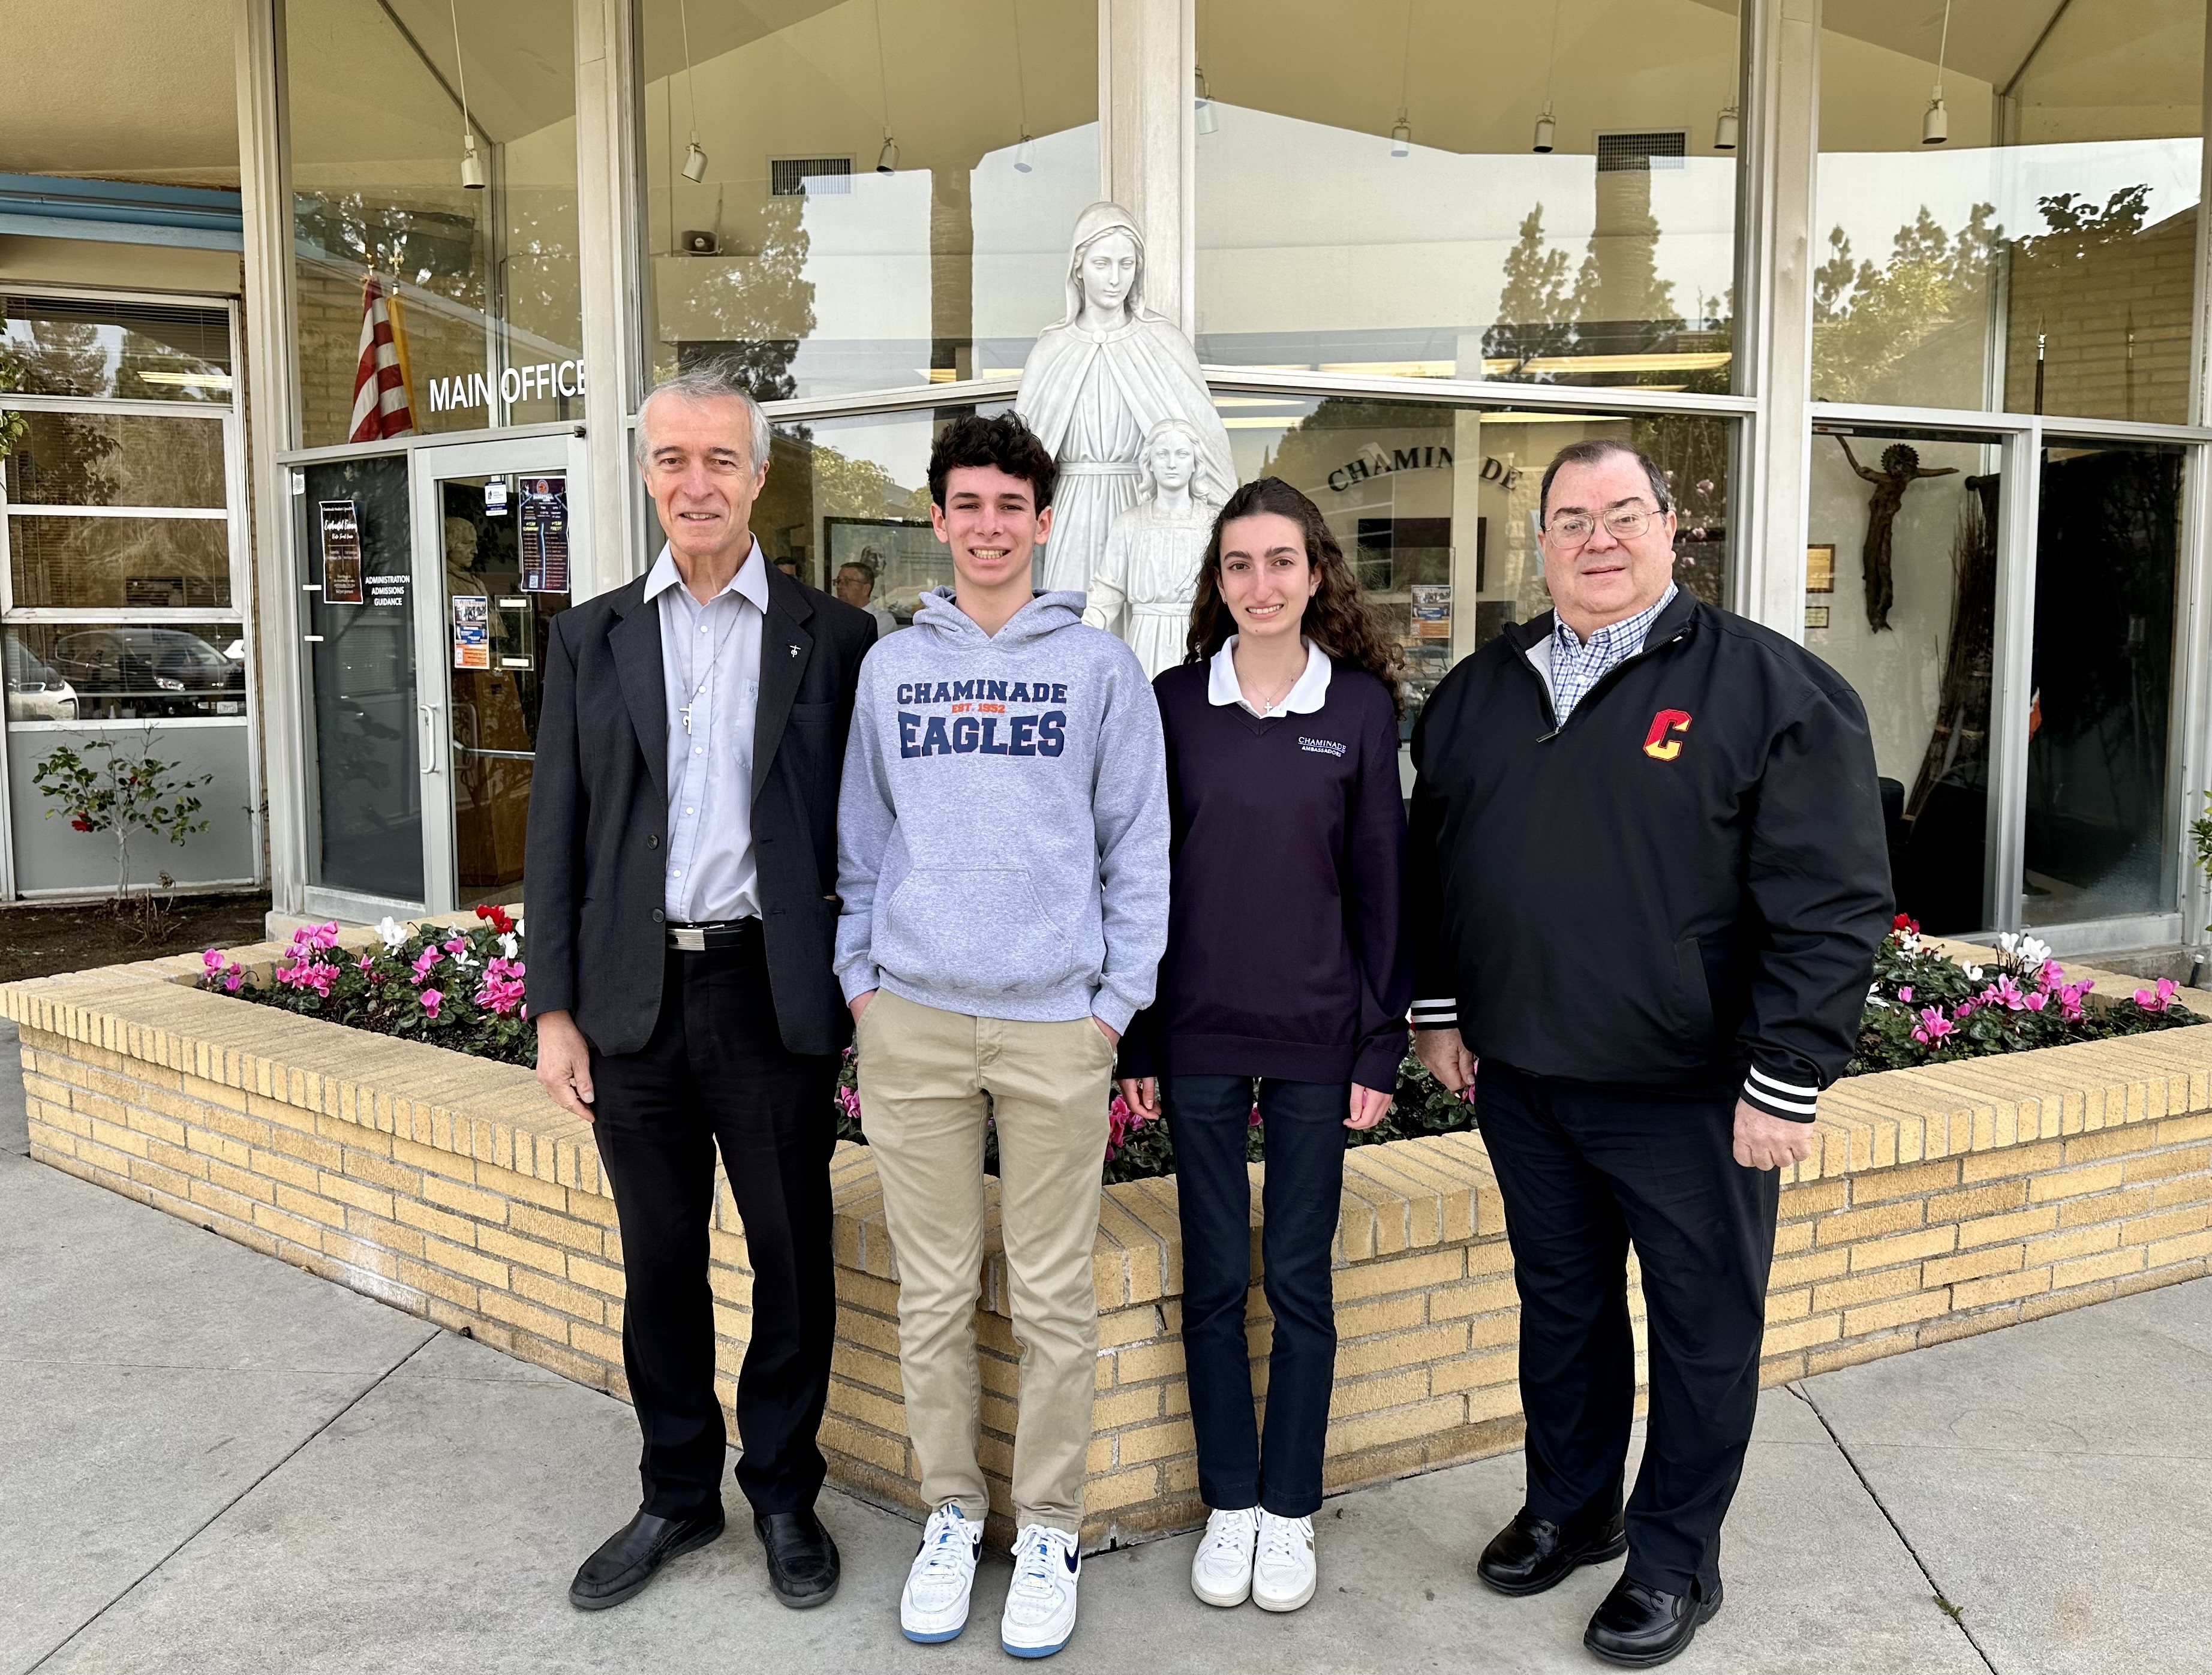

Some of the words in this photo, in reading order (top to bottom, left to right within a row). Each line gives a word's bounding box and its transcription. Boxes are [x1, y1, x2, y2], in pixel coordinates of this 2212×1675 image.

[429, 371, 492, 412] MAIN
[1327, 447, 1523, 492] CHAMINDE
[365, 575, 410, 584] ADMINISTRATION
[371, 587, 404, 595] ADMISSIONS
[374, 597, 402, 606] GUIDANCE
[897, 679, 1068, 705] CHAMINADE
[951, 703, 975, 714] EST.
[978, 702, 1006, 714] 1952
[898, 710, 1067, 759] EAGLES
[1643, 709, 1693, 762] C
[1298, 736, 1347, 753] CHAMINADE
[1302, 745, 1342, 757] AMBASSADORS
